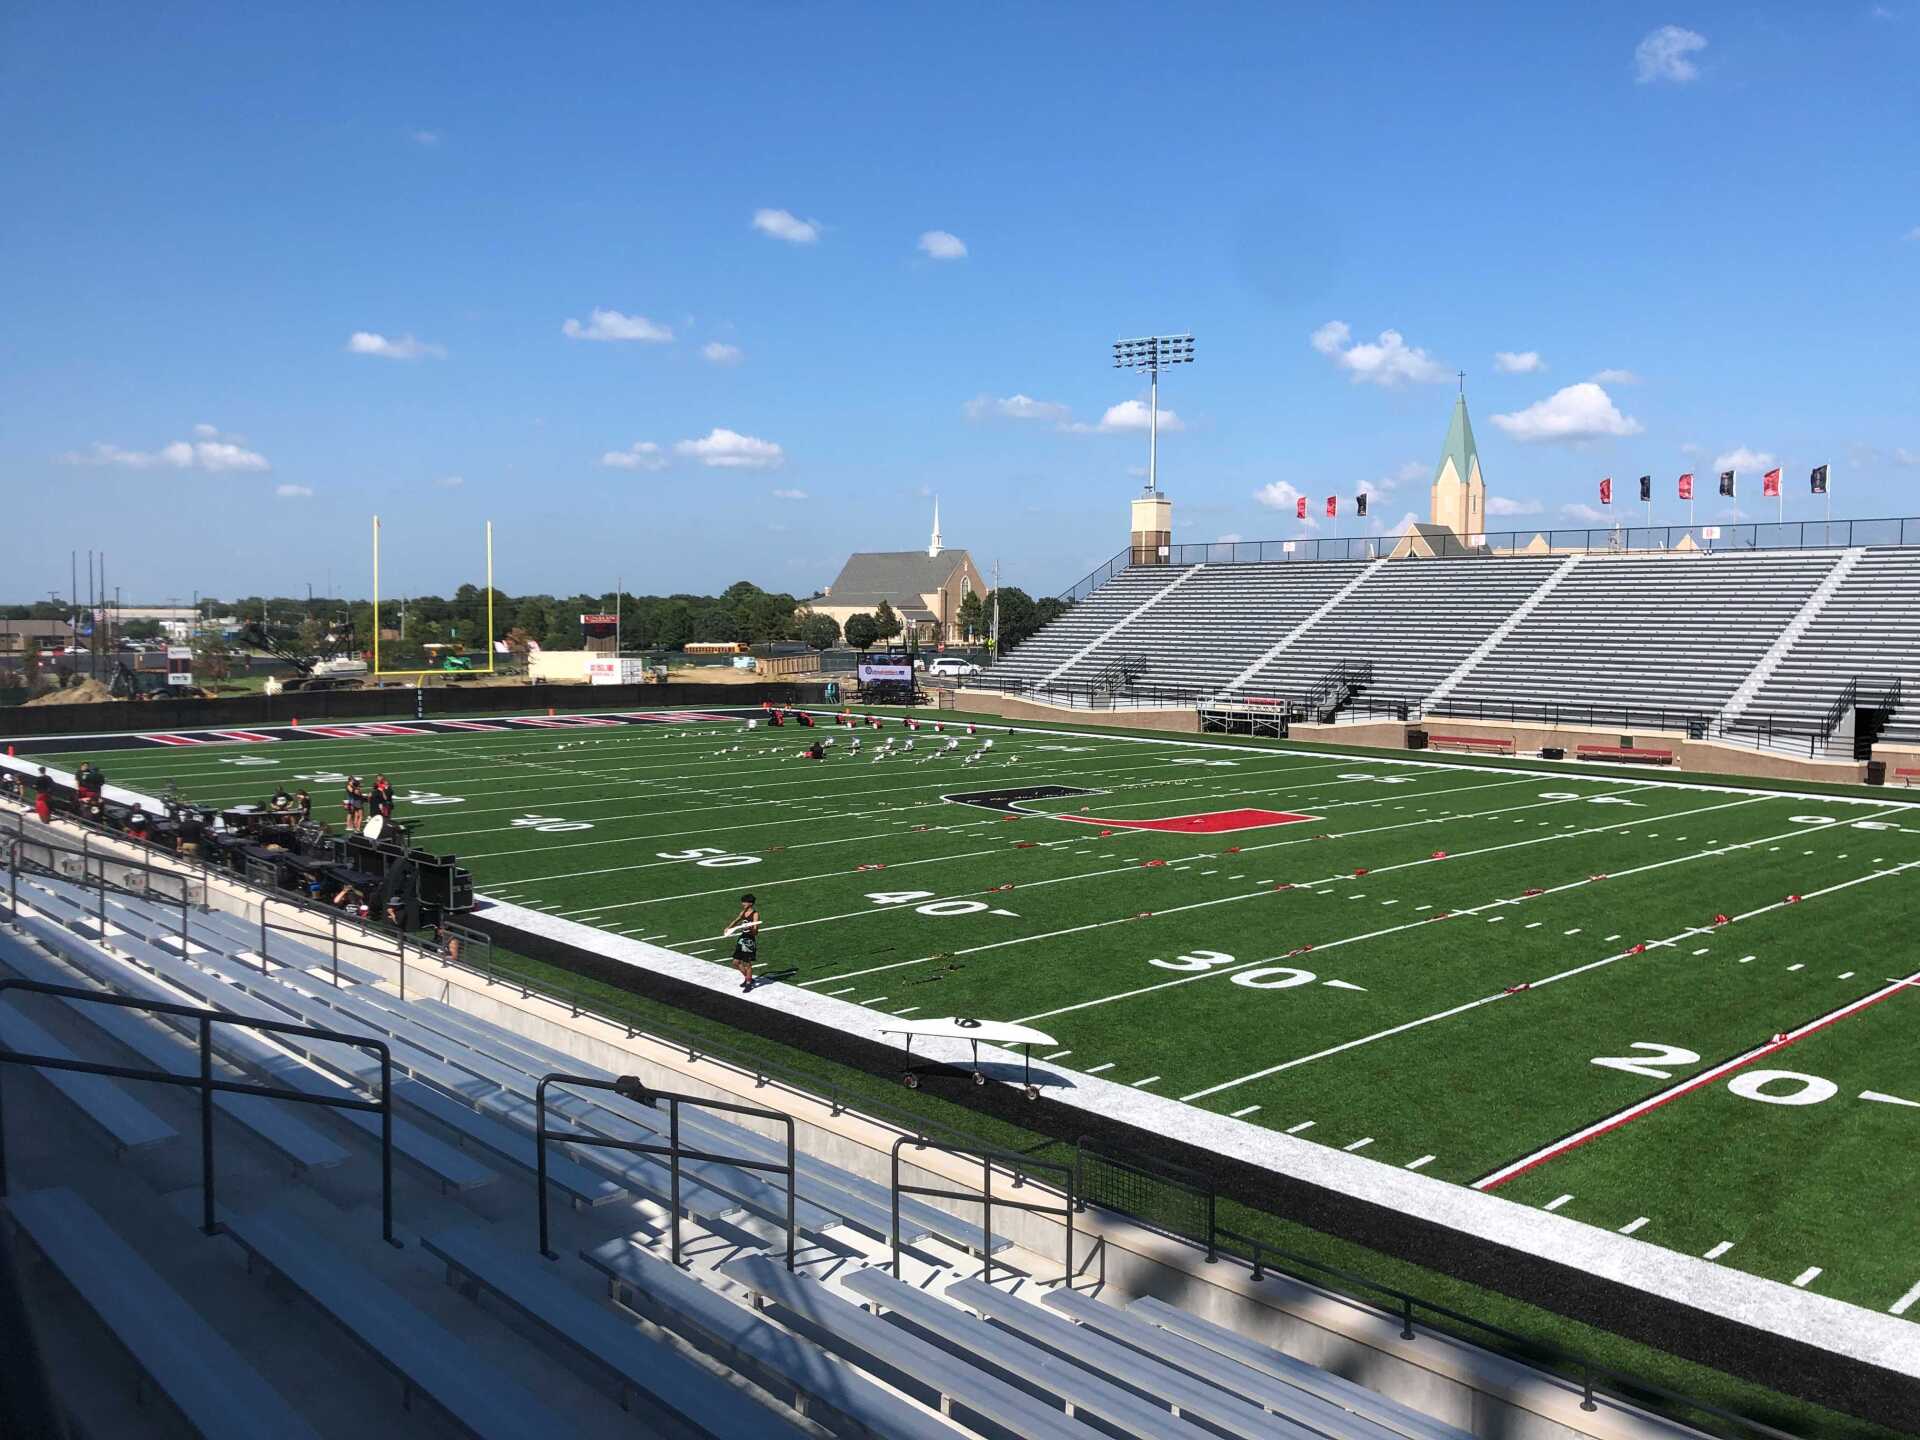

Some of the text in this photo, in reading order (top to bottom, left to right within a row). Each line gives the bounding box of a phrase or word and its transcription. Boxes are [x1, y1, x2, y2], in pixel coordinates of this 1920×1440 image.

[136, 712, 745, 746] UNION
[510, 816, 595, 832] 40
[656, 847, 763, 867] 50
[864, 890, 988, 916] 40
[1148, 950, 1317, 989] 30
[1590, 1042, 1839, 1106] 20
